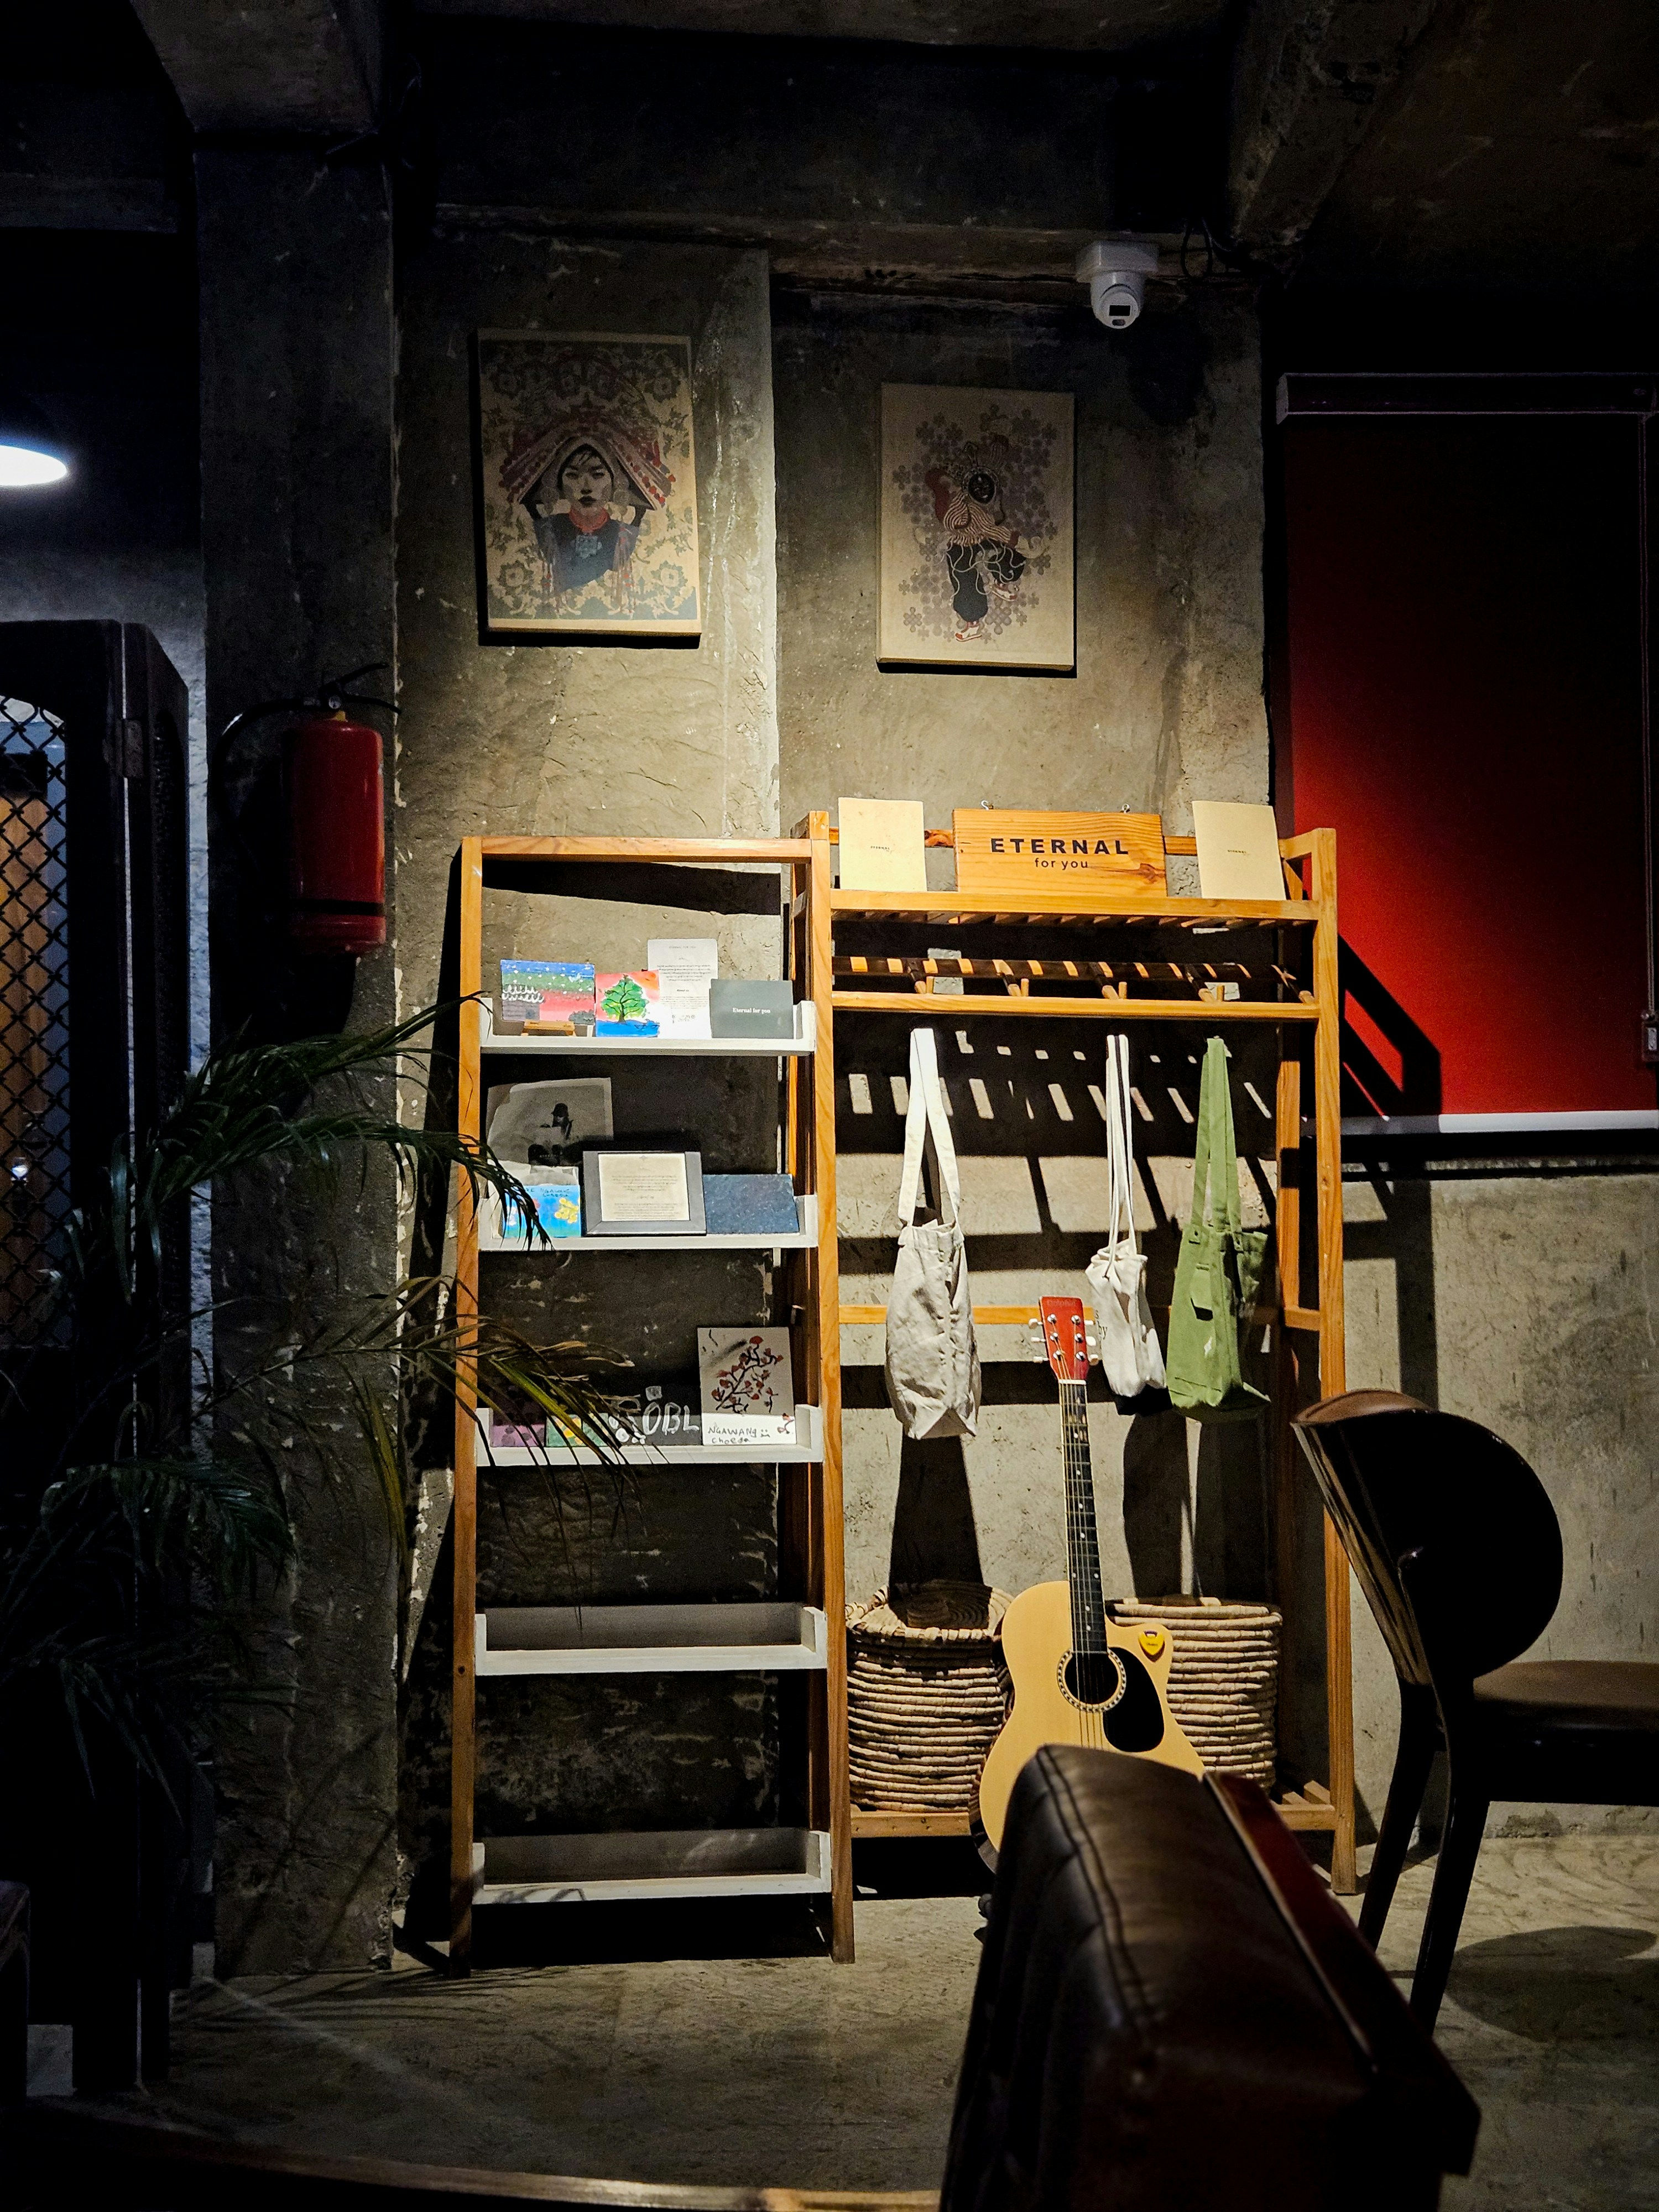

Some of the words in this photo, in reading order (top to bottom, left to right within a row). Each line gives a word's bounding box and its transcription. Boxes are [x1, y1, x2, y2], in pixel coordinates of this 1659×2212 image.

[990, 838, 1129, 855] ETERNAL
[1035, 858, 1056, 868] for
[1061, 860, 1088, 870] you
